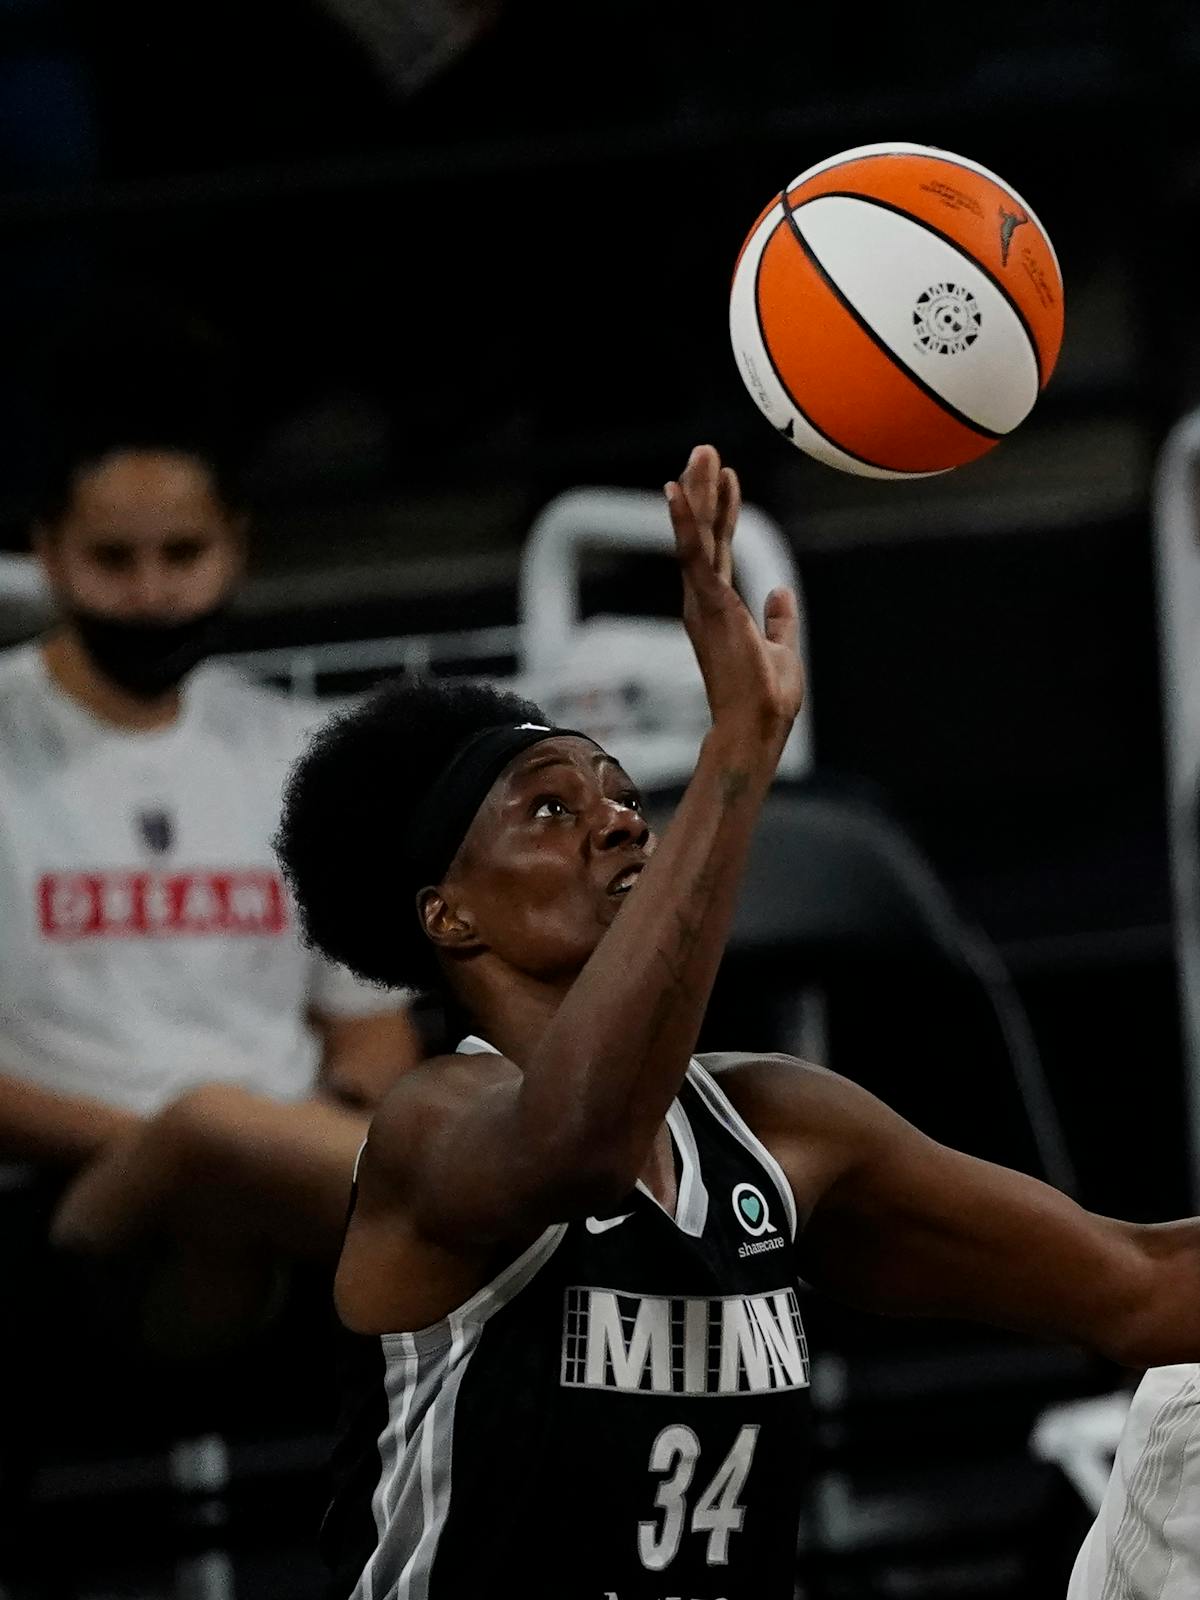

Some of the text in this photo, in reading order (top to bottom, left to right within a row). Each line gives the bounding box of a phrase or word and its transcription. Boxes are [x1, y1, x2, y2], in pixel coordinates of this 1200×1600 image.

[738, 1236, 785, 1258] sharecare
[585, 1288, 808, 1393] MINN
[637, 1423, 761, 1571] 34
